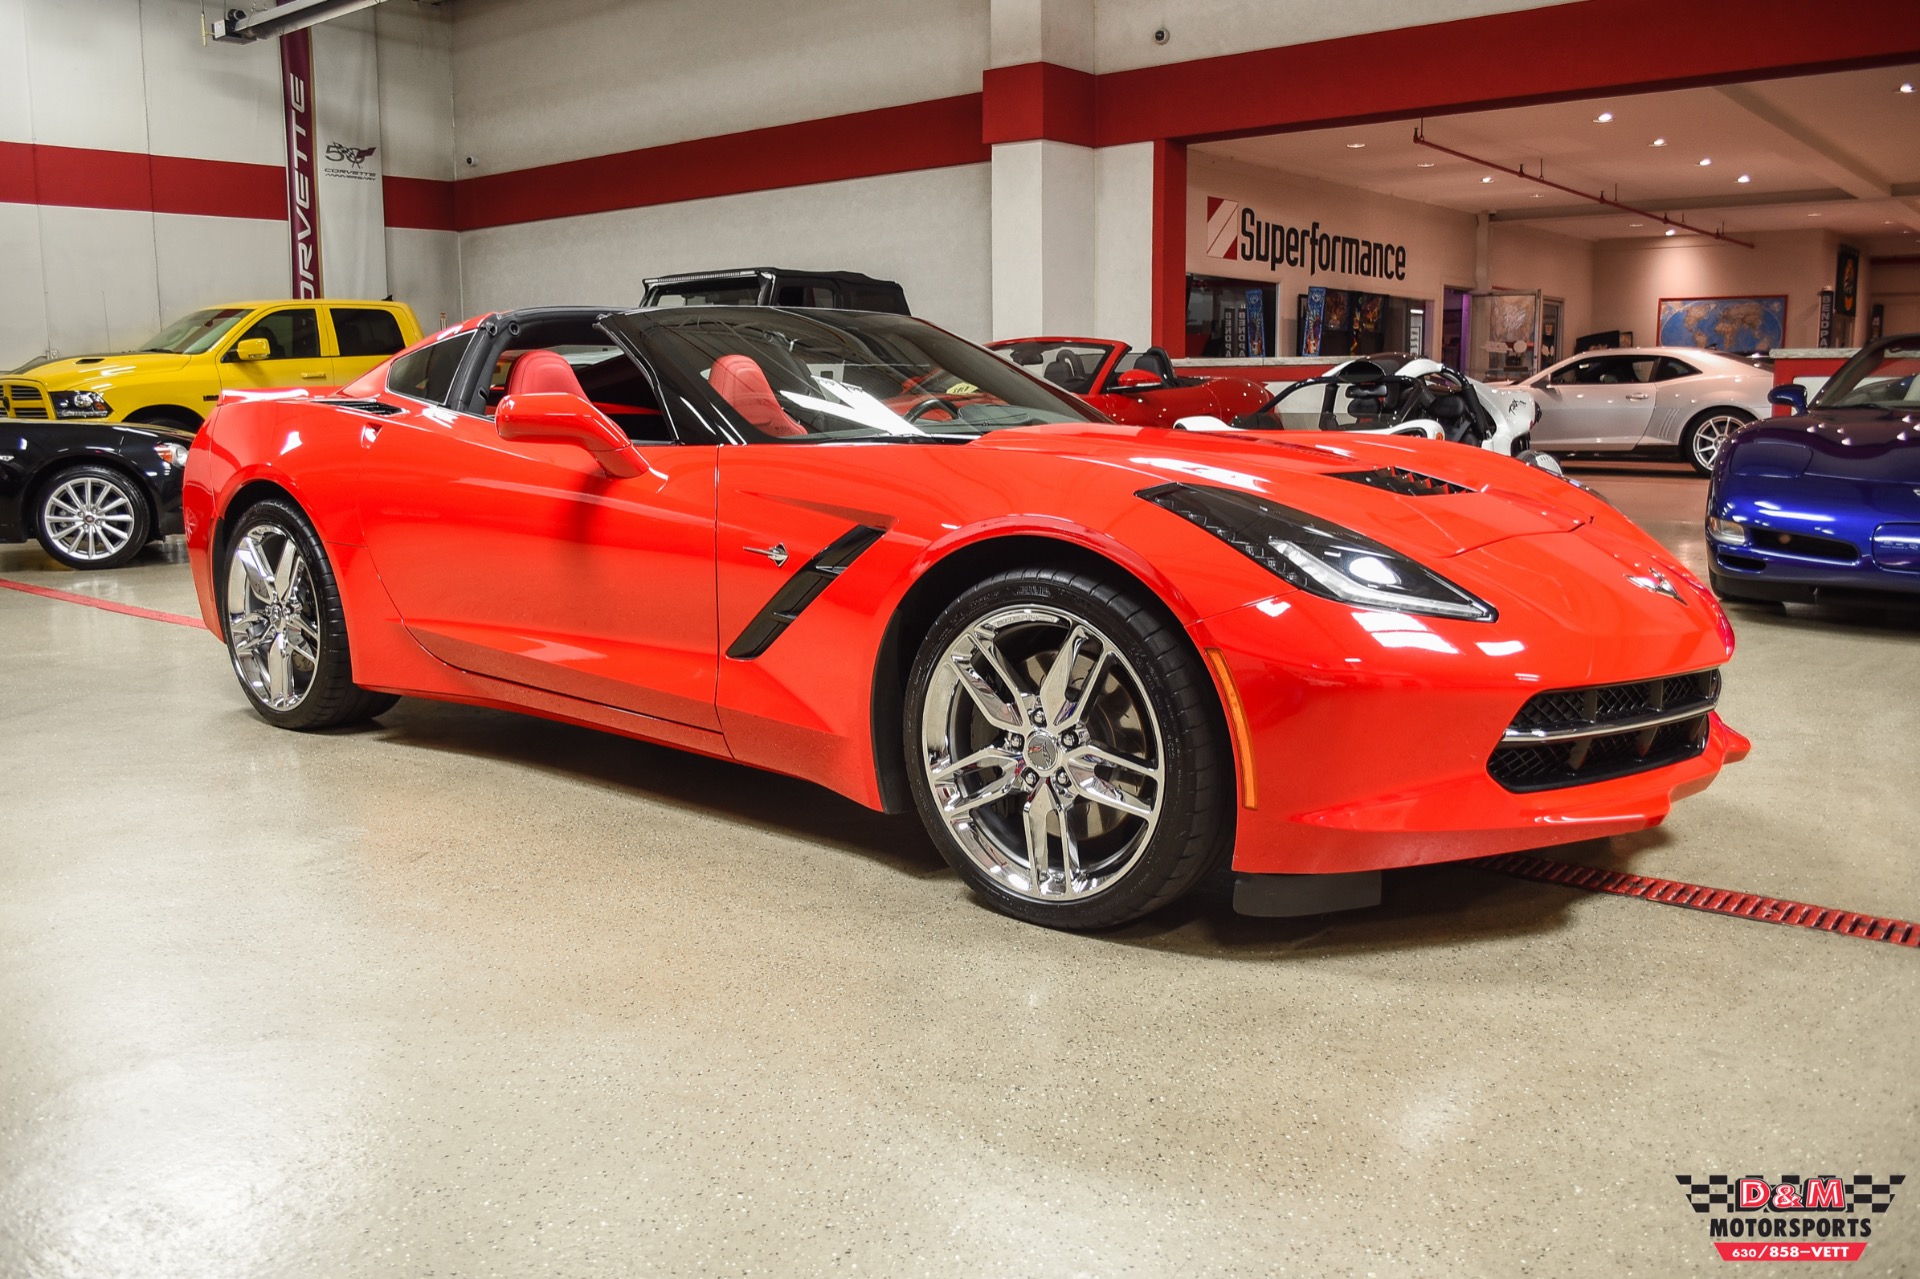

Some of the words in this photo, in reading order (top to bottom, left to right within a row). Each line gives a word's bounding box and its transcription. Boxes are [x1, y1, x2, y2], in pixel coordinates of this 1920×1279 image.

[289, 72, 314, 299] ORVETTE
[324, 168, 377, 177] CORVETTE
[1241, 207, 1406, 280] Superformance
[1820, 295, 1831, 346] BENDPA
